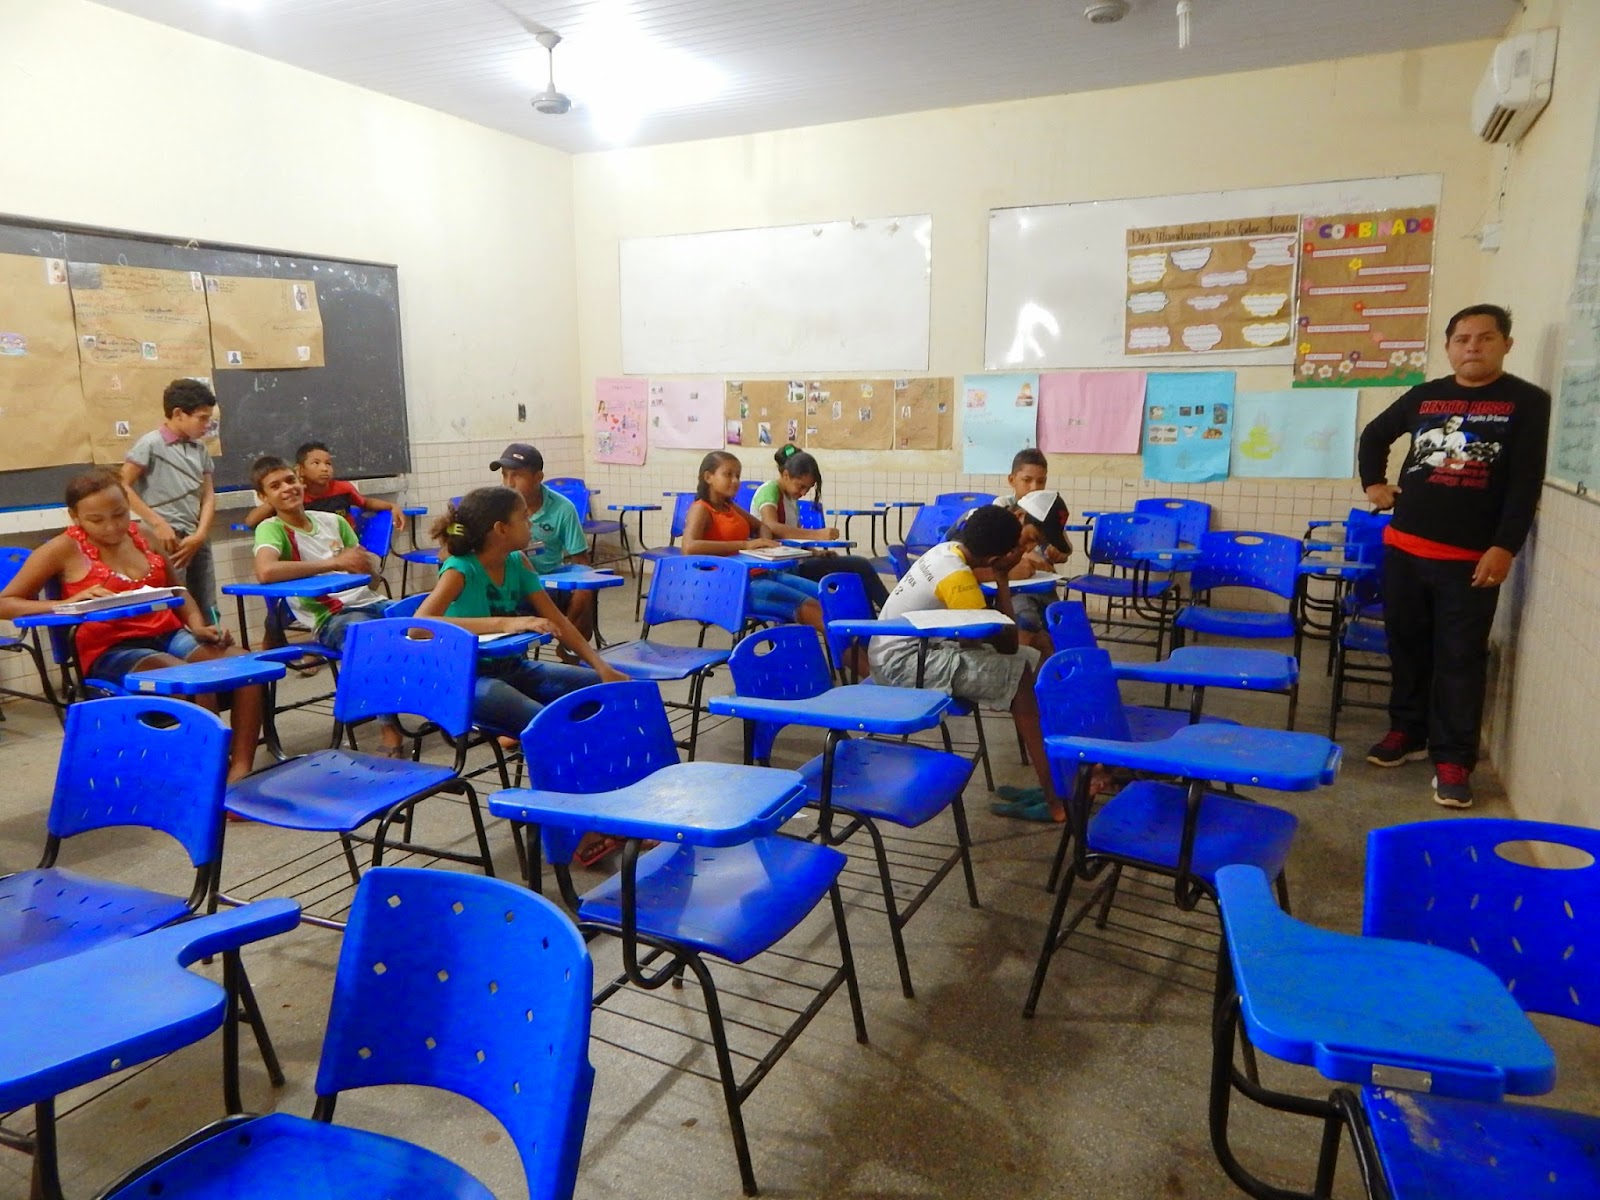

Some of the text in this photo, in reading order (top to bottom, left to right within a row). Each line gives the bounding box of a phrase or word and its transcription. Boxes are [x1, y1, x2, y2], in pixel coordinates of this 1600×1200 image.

[1319, 218, 1434, 240] COMBINADO
[1419, 400, 1514, 415] RENATO RUSSO
